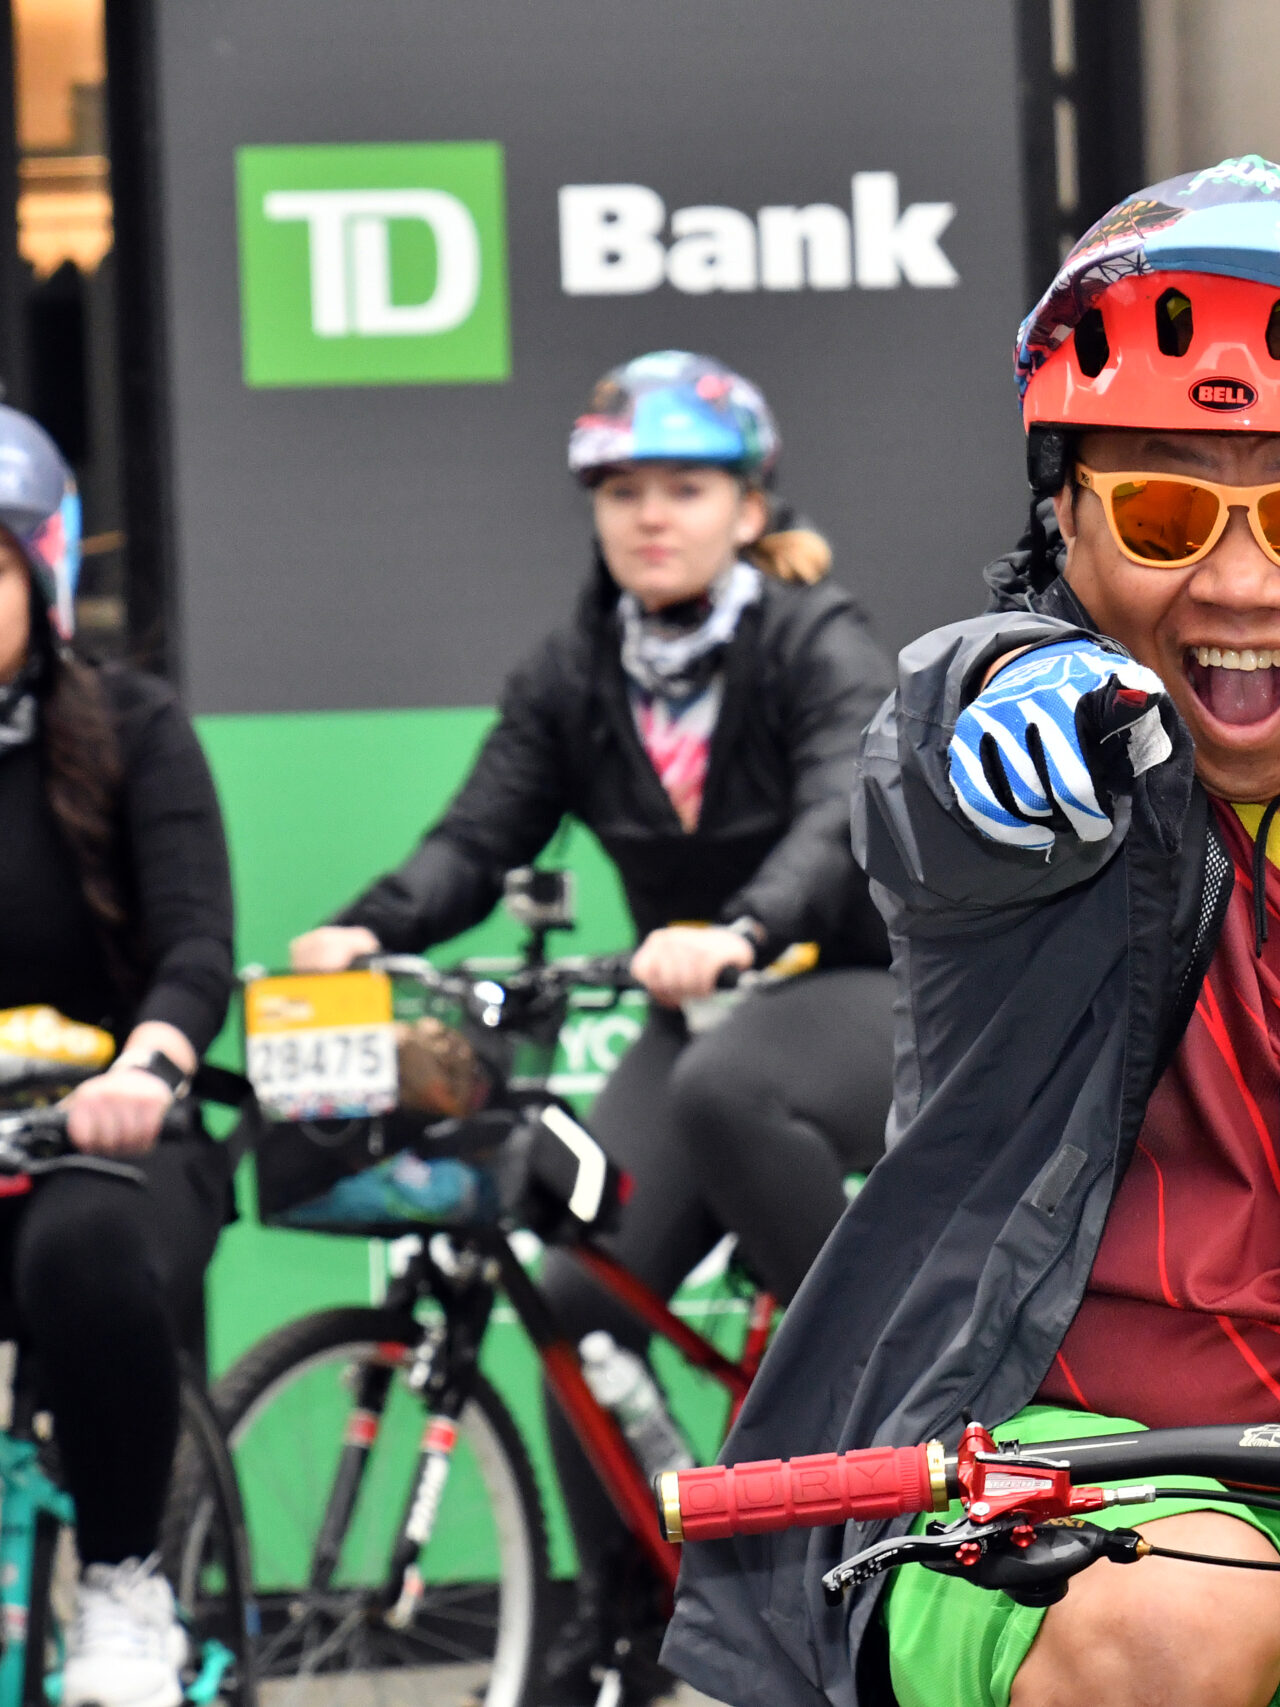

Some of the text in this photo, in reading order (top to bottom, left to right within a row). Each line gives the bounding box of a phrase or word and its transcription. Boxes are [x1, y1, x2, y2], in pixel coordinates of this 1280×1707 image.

[263, 171, 960, 338] TD Bank
[1199, 386, 1248, 405] BELL
[688, 1464, 885, 1510] OURY
